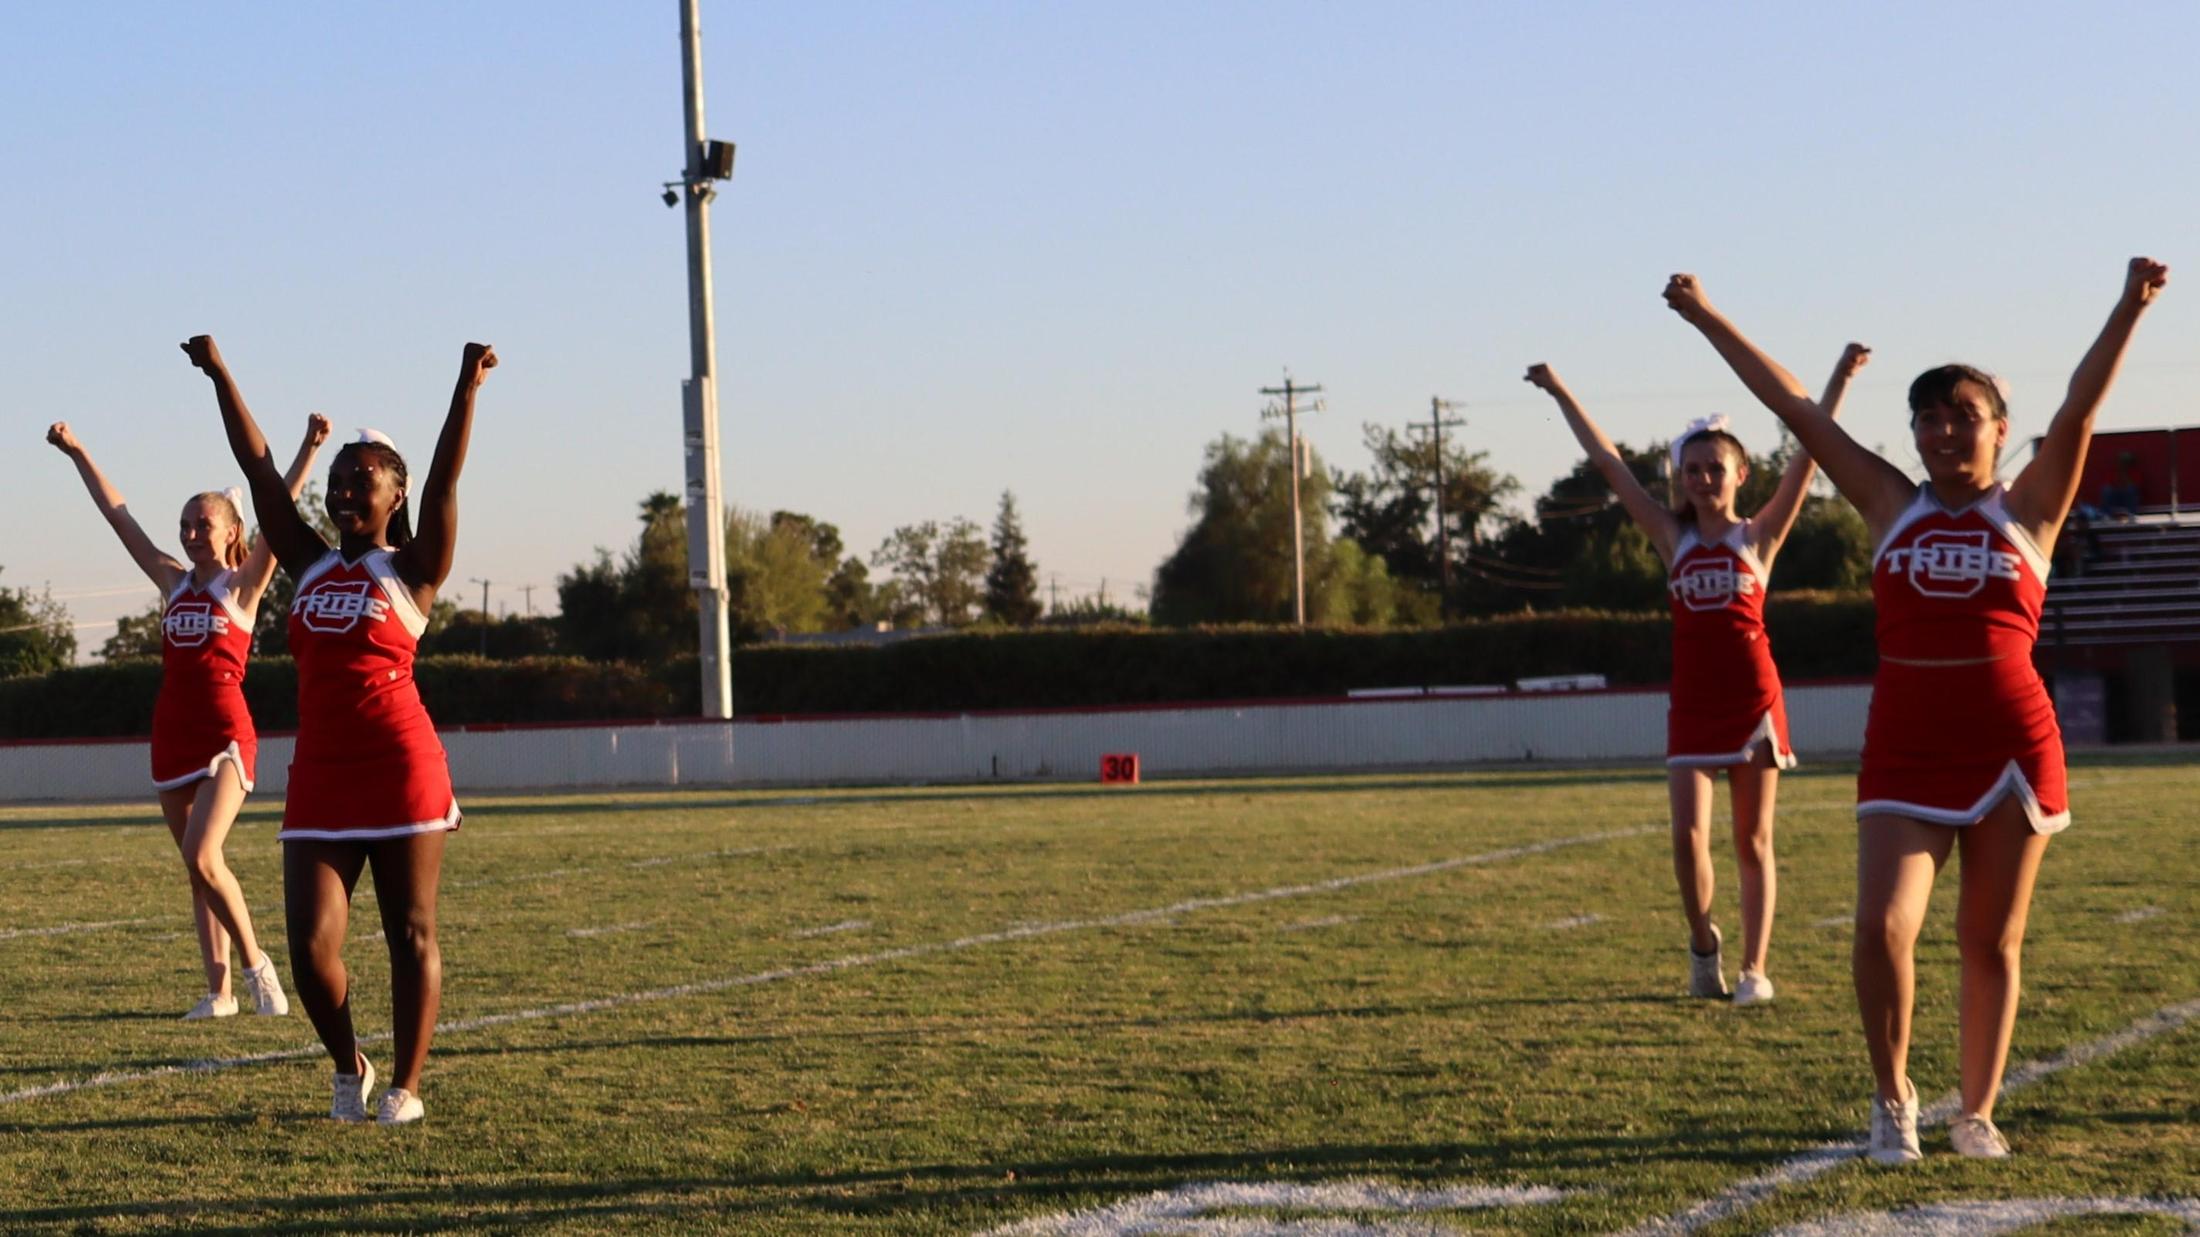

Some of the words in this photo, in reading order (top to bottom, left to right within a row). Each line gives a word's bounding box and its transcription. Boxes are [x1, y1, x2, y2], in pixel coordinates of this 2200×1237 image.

[1885, 547, 2022, 581] TRIBE
[1670, 571, 1756, 600] TRIBE
[292, 595, 392, 623] TRIBE
[1105, 756, 1135, 781] 30
